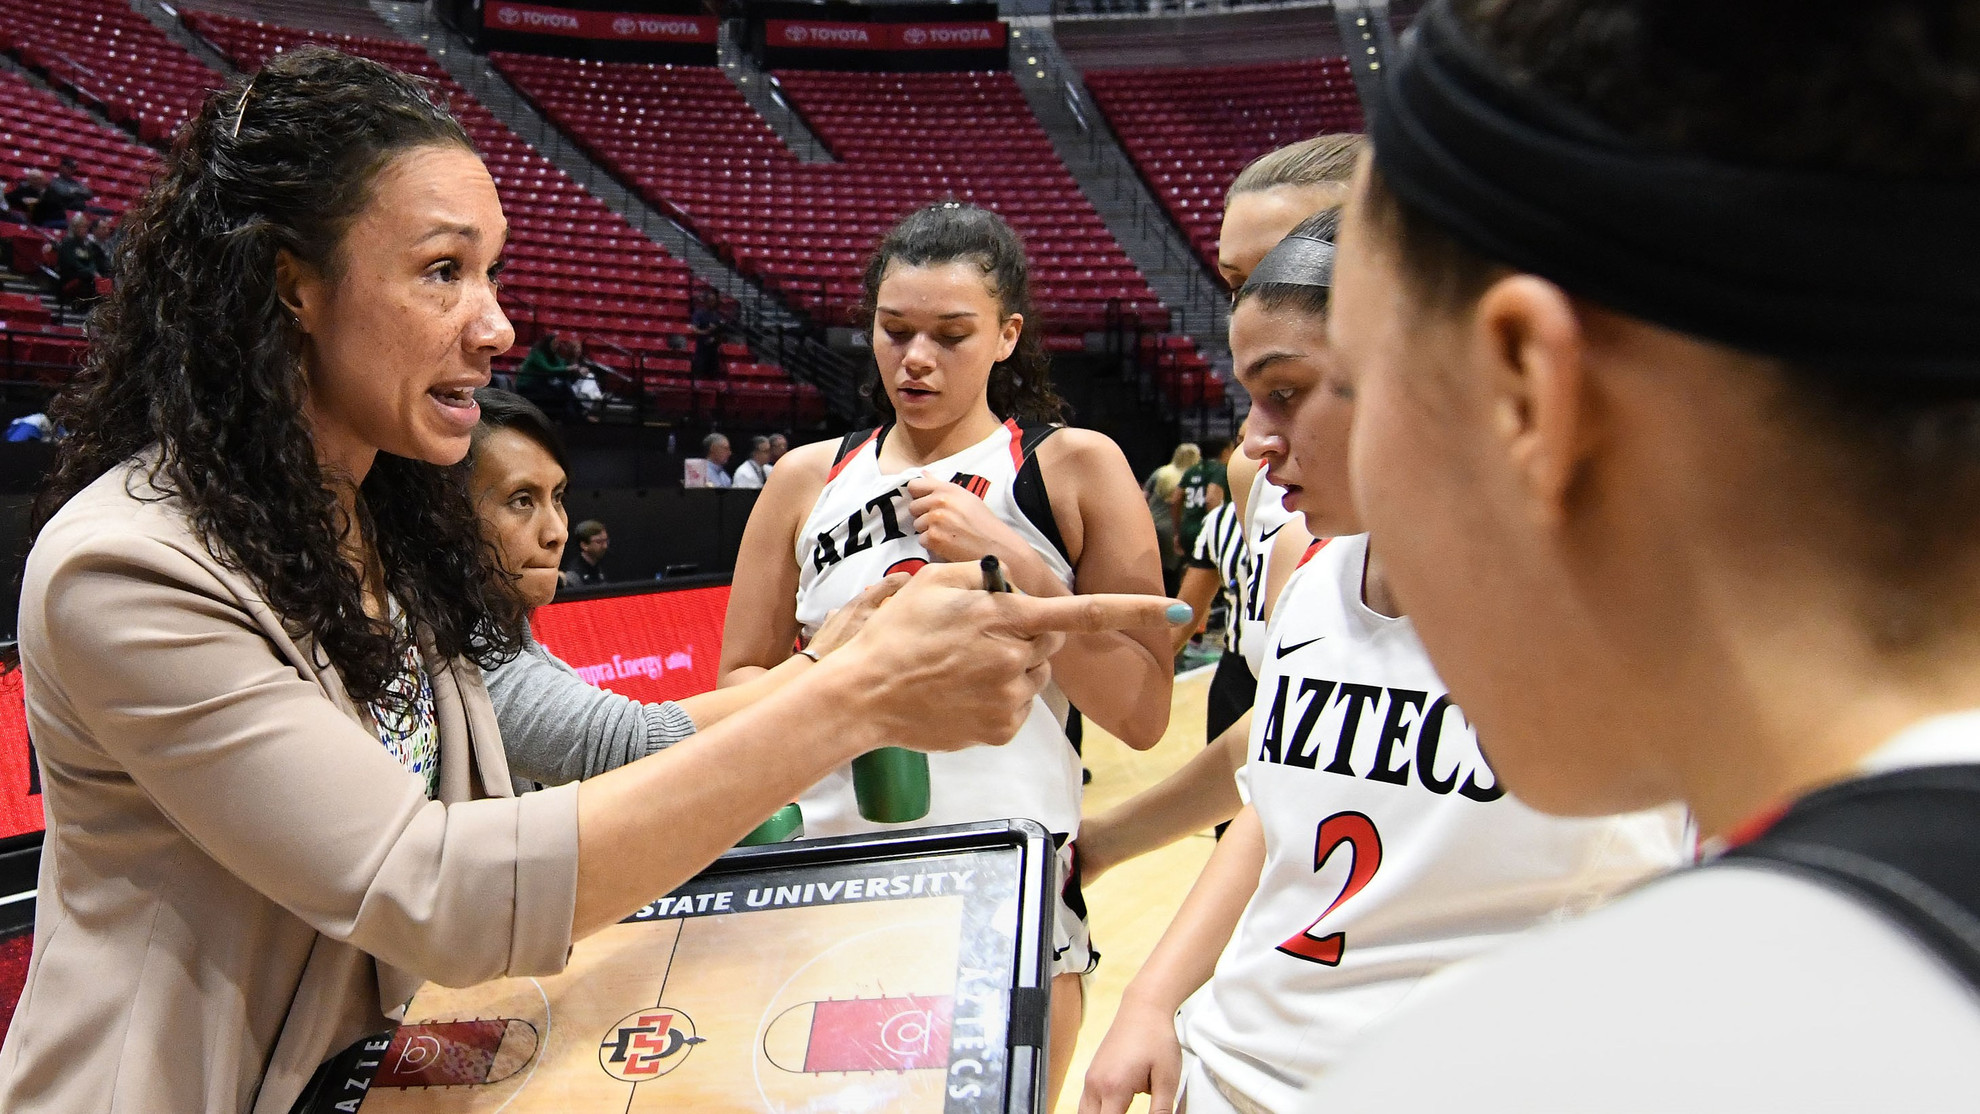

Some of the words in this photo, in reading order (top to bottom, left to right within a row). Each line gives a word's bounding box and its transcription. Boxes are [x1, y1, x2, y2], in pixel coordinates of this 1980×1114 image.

[522, 11, 579, 29] TOYOTA
[638, 20, 699, 35] TOYOTA
[810, 27, 868, 41] TOYOTA
[929, 28, 990, 41] TOYOTA
[1185, 486, 1206, 509] 34
[814, 477, 921, 575] AZT
[576, 662, 616, 688] mpra
[612, 654, 662, 680] Energy
[636, 891, 734, 918] STATE
[746, 870, 976, 908] UNIVERSITY
[1275, 811, 1383, 967] 2
[949, 966, 1006, 1099] AZTECS
[334, 1029, 392, 1113] AZTE
